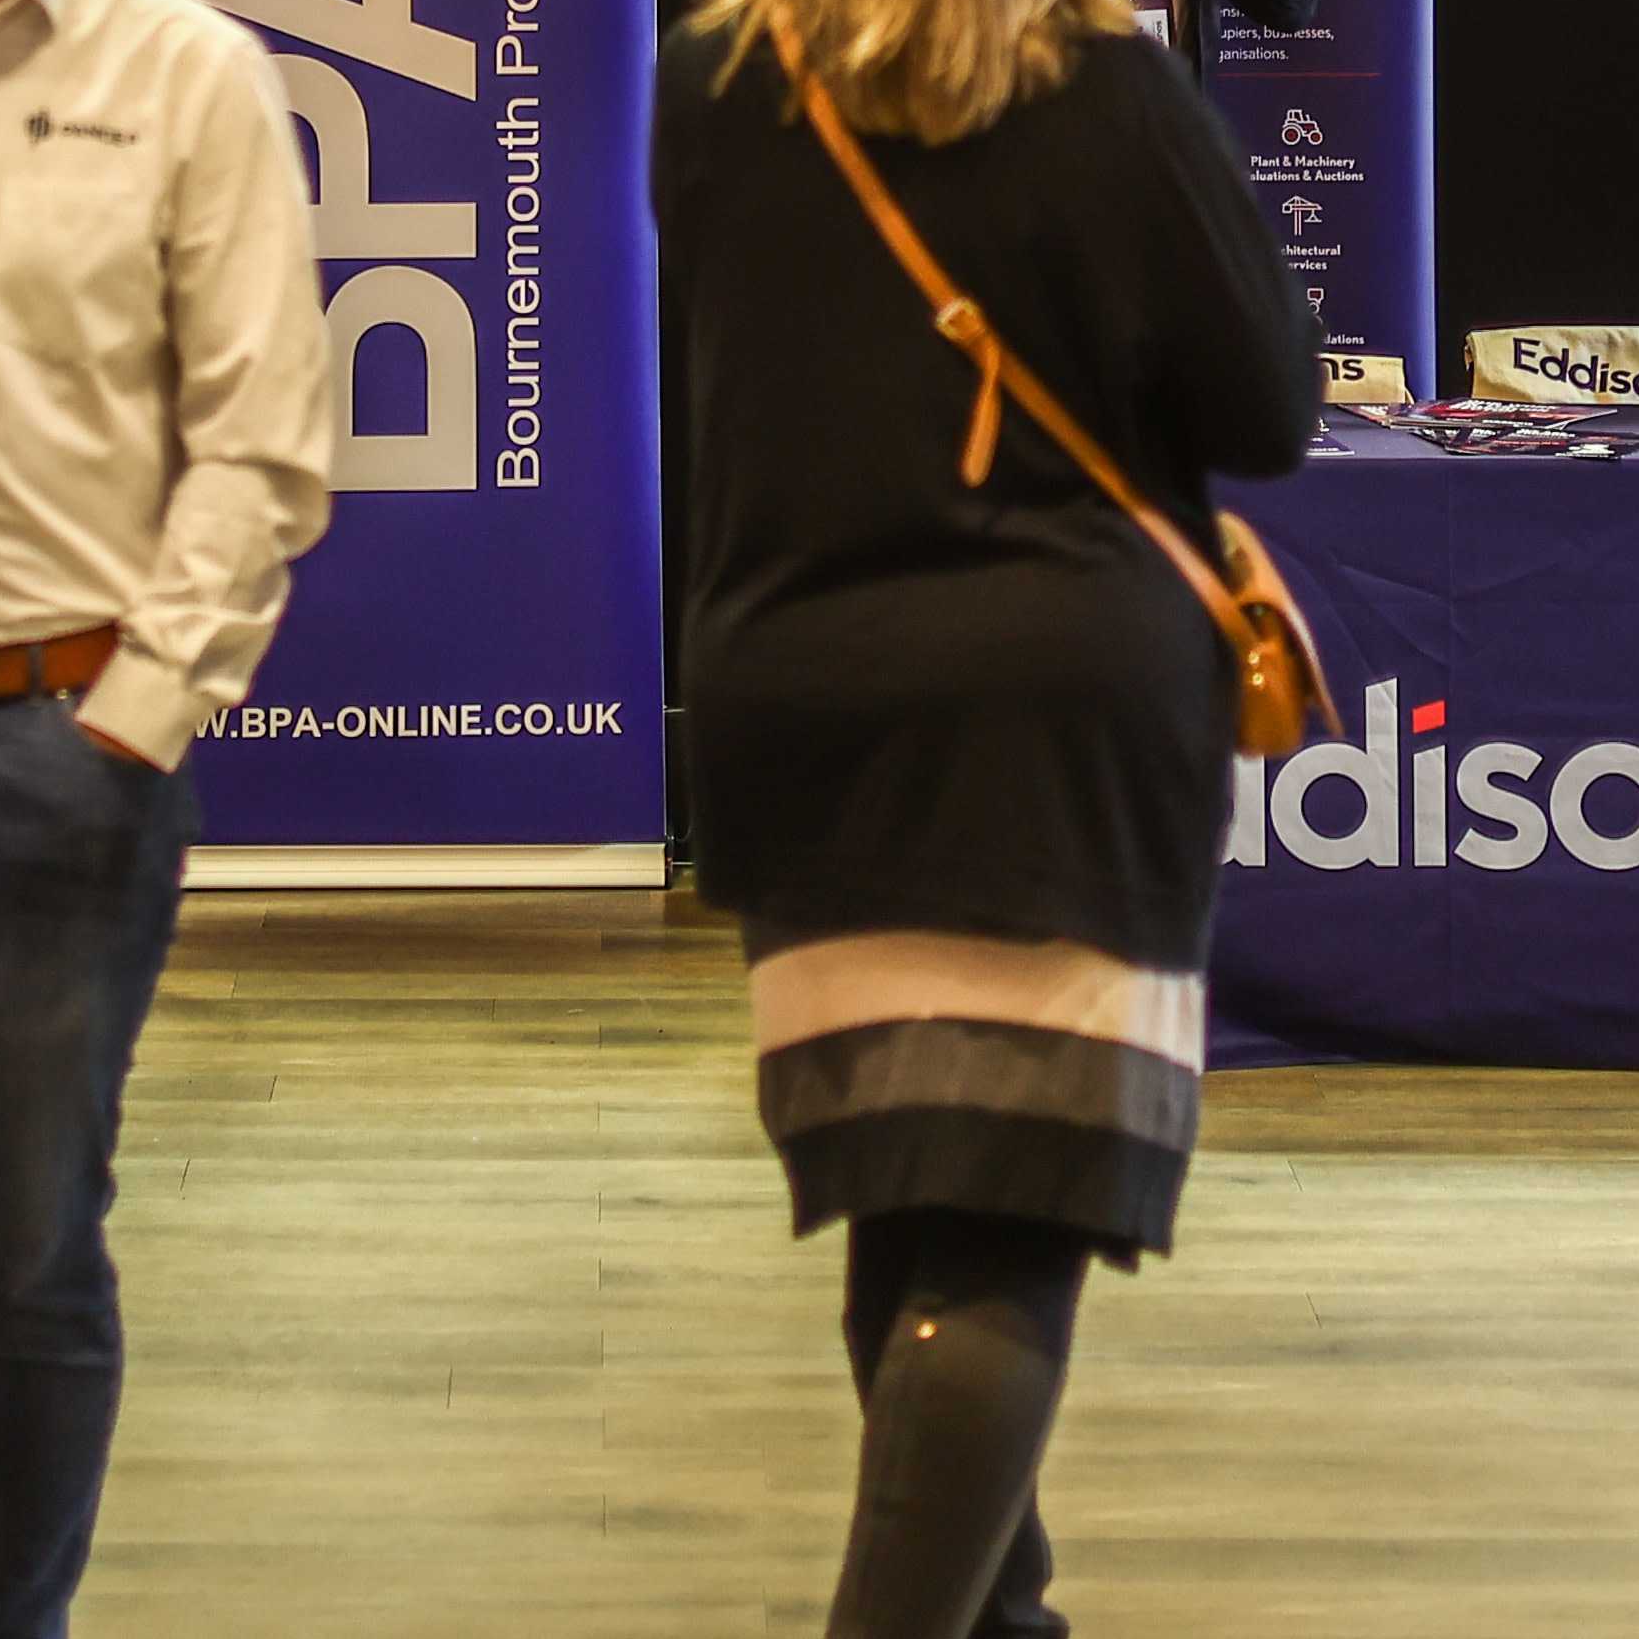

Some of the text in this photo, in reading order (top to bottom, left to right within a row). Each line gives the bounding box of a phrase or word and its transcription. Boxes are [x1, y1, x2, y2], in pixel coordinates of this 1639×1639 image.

[1250, 155, 1356, 170] Plant & Machinery
[1302, 170, 1313, 182] &
[1314, 170, 1365, 182] Auctions
[496, 97, 541, 488] Bournemouth
